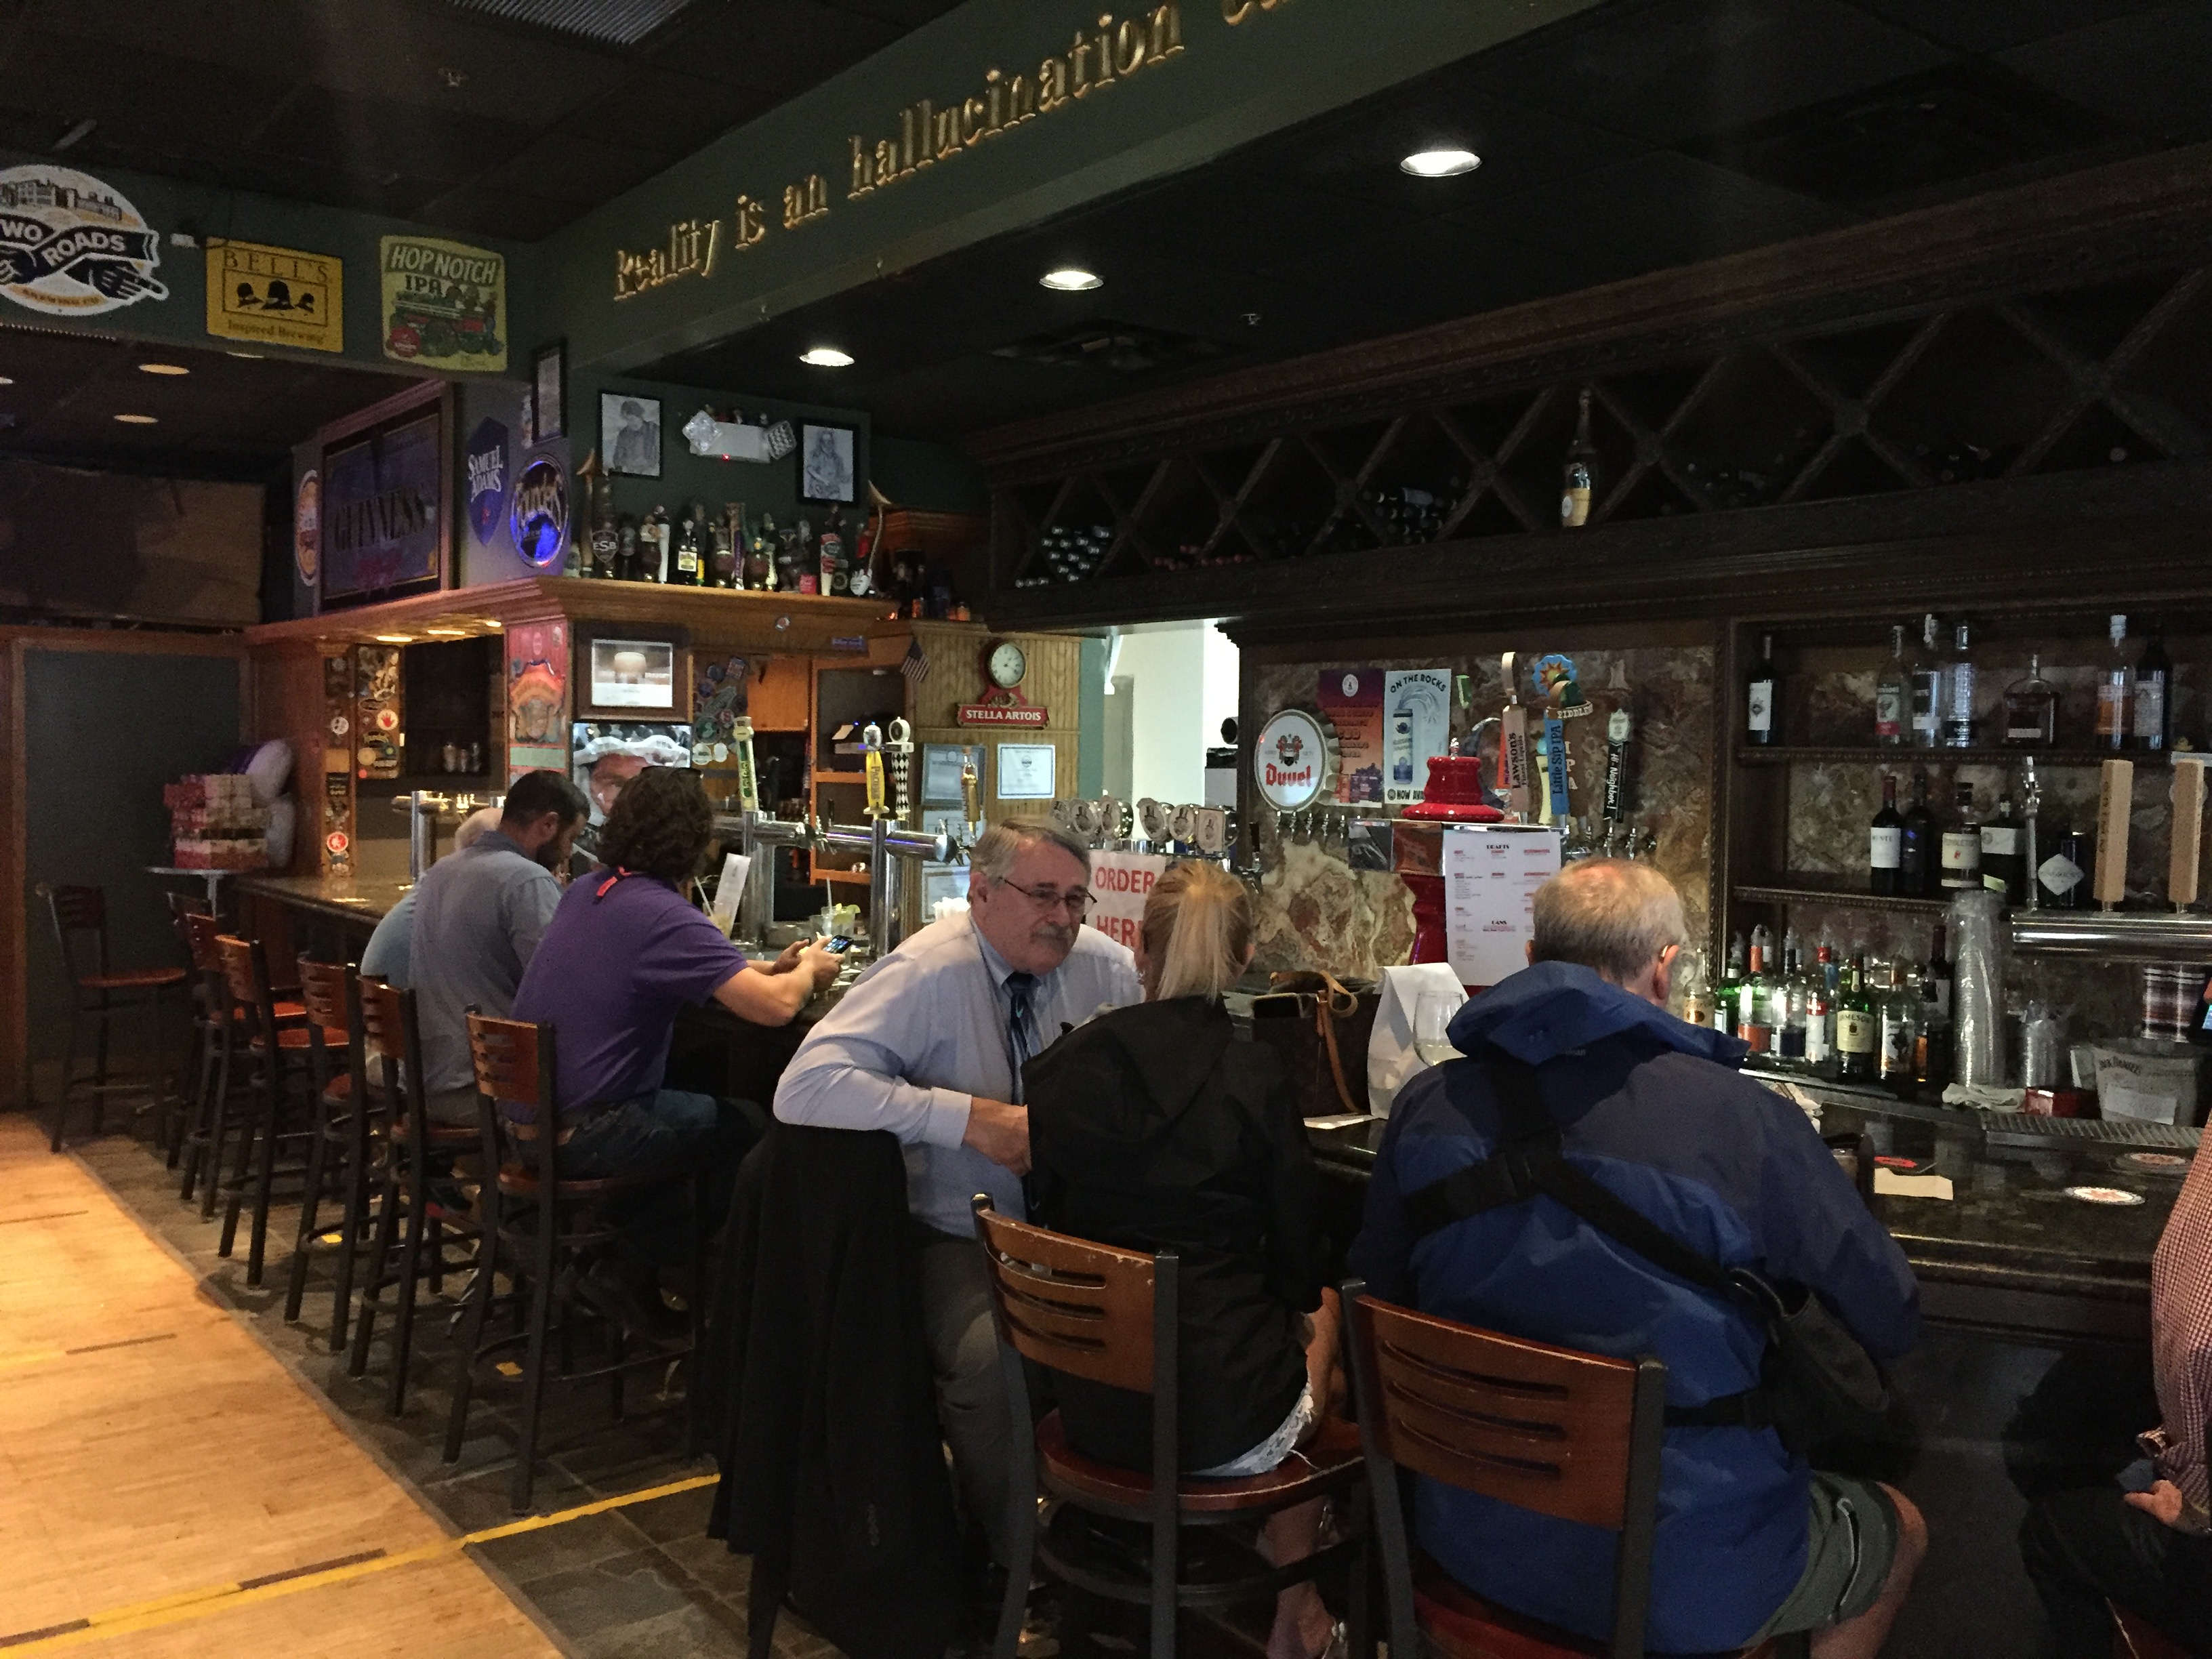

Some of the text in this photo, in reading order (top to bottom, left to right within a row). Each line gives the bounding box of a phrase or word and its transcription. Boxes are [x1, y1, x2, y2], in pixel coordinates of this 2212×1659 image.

[613, 4, 1185, 301] Reality is an hallucination
[0, 218, 43, 242] WO
[41, 232, 126, 268] ROADS
[390, 245, 497, 284] HOP NOTCH
[405, 274, 442, 295] IPA
[468, 445, 504, 480] SAMUEL
[470, 468, 502, 502] ADAMS
[334, 486, 427, 550] GUINNESS
[592, 540, 617, 552] ESB
[1390, 673, 1446, 693] ON THE ROCKS
[966, 709, 1042, 721] STELLA ARTOIS
[1508, 733, 1521, 789] Lawson's
[1518, 735, 1526, 762] Liquids
[1550, 725, 1563, 795] Little Sip IPA
[1265, 762, 1311, 787] Duvel
[1095, 866, 1155, 894] ORDER
[1097, 915, 1144, 947] HER
